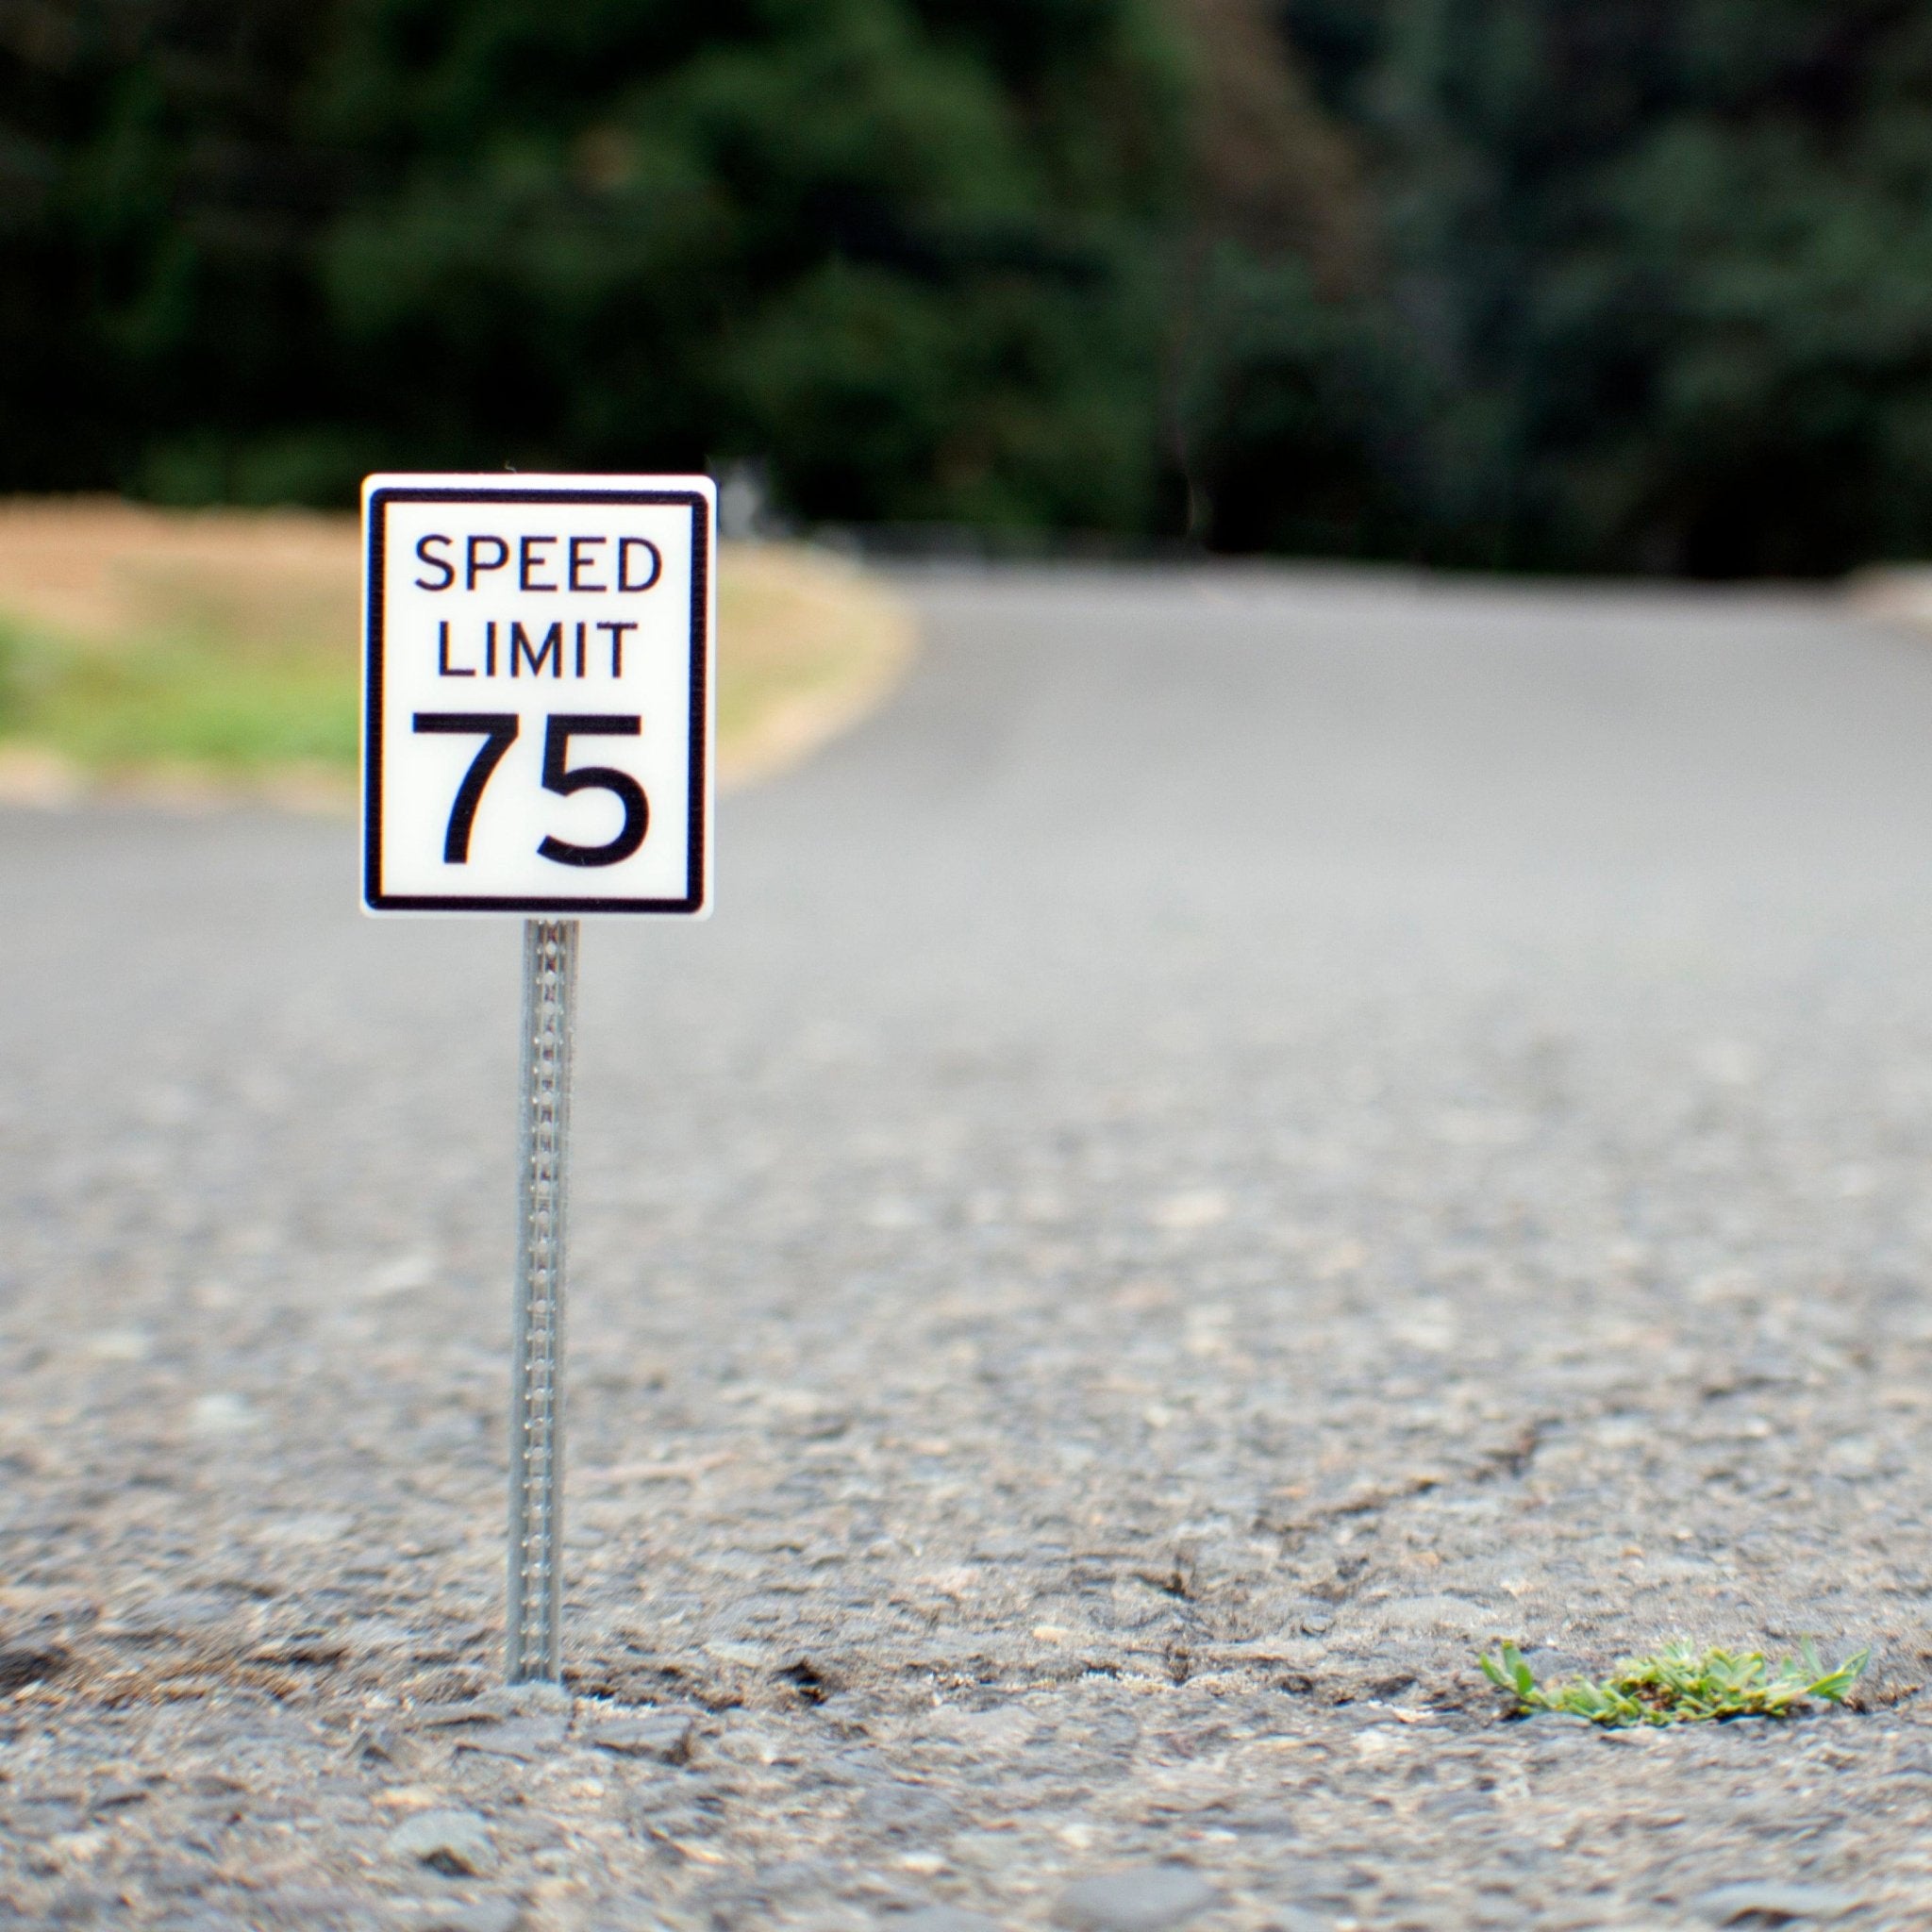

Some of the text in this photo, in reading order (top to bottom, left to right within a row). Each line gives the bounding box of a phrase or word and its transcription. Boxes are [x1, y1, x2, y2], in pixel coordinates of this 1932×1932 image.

[415, 534, 662, 591] SPEED
[439, 621, 638, 678] LIMIT
[412, 712, 649, 868] 75
